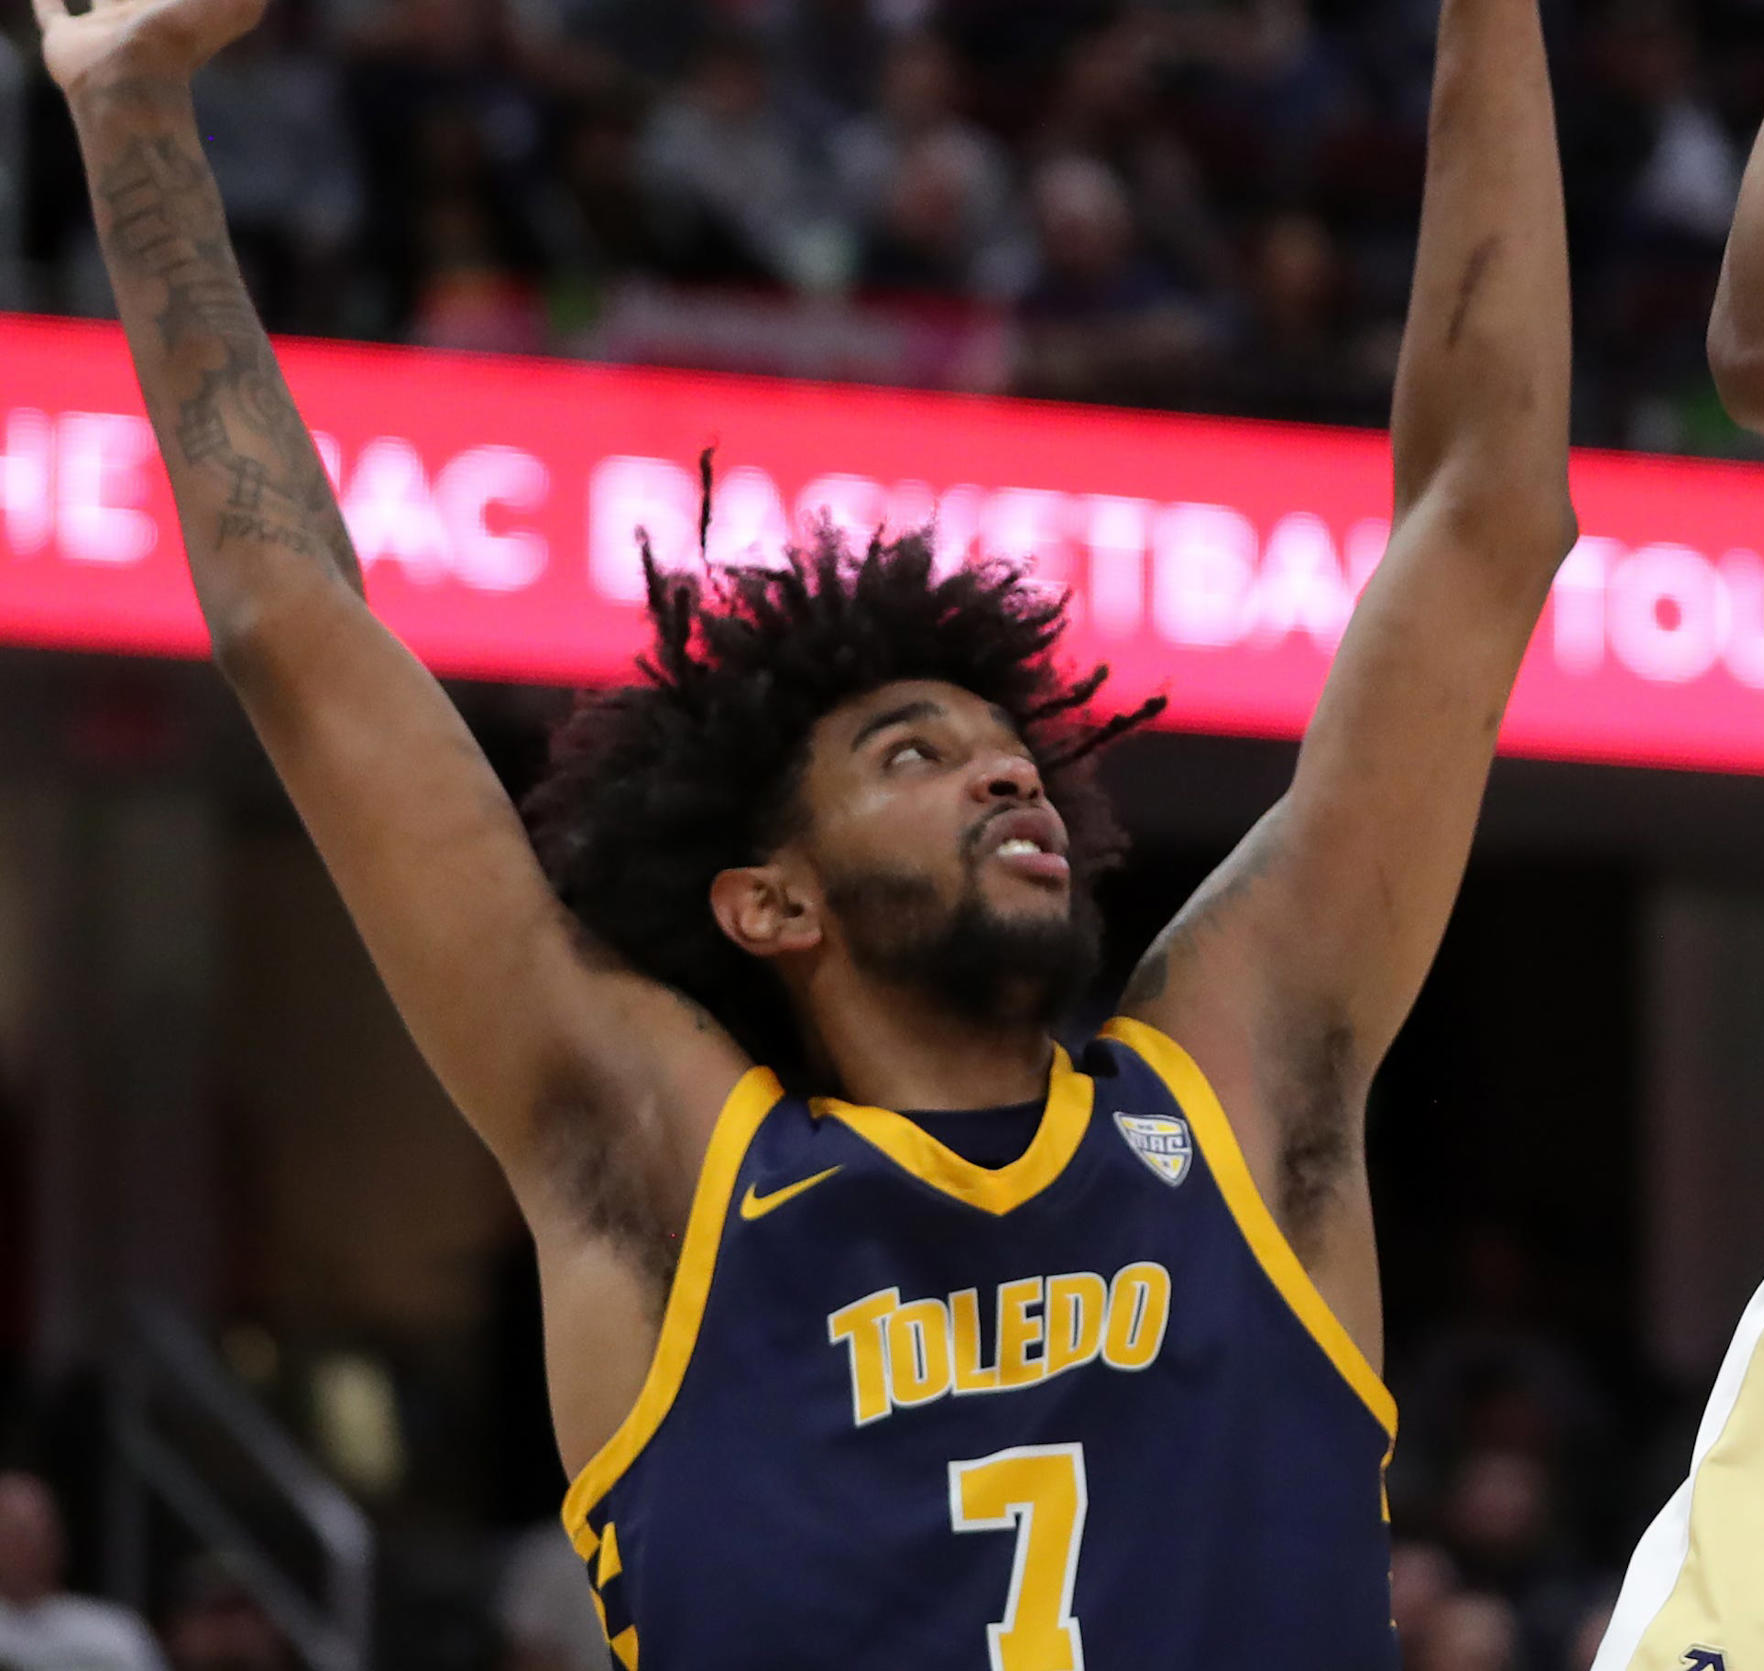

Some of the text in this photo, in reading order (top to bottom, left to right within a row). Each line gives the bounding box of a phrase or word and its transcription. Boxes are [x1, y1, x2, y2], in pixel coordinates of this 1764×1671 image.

[312, 430, 549, 592] AC
[828, 1262, 1171, 1427] TOLEDO
[949, 1442, 1088, 1671] 7
